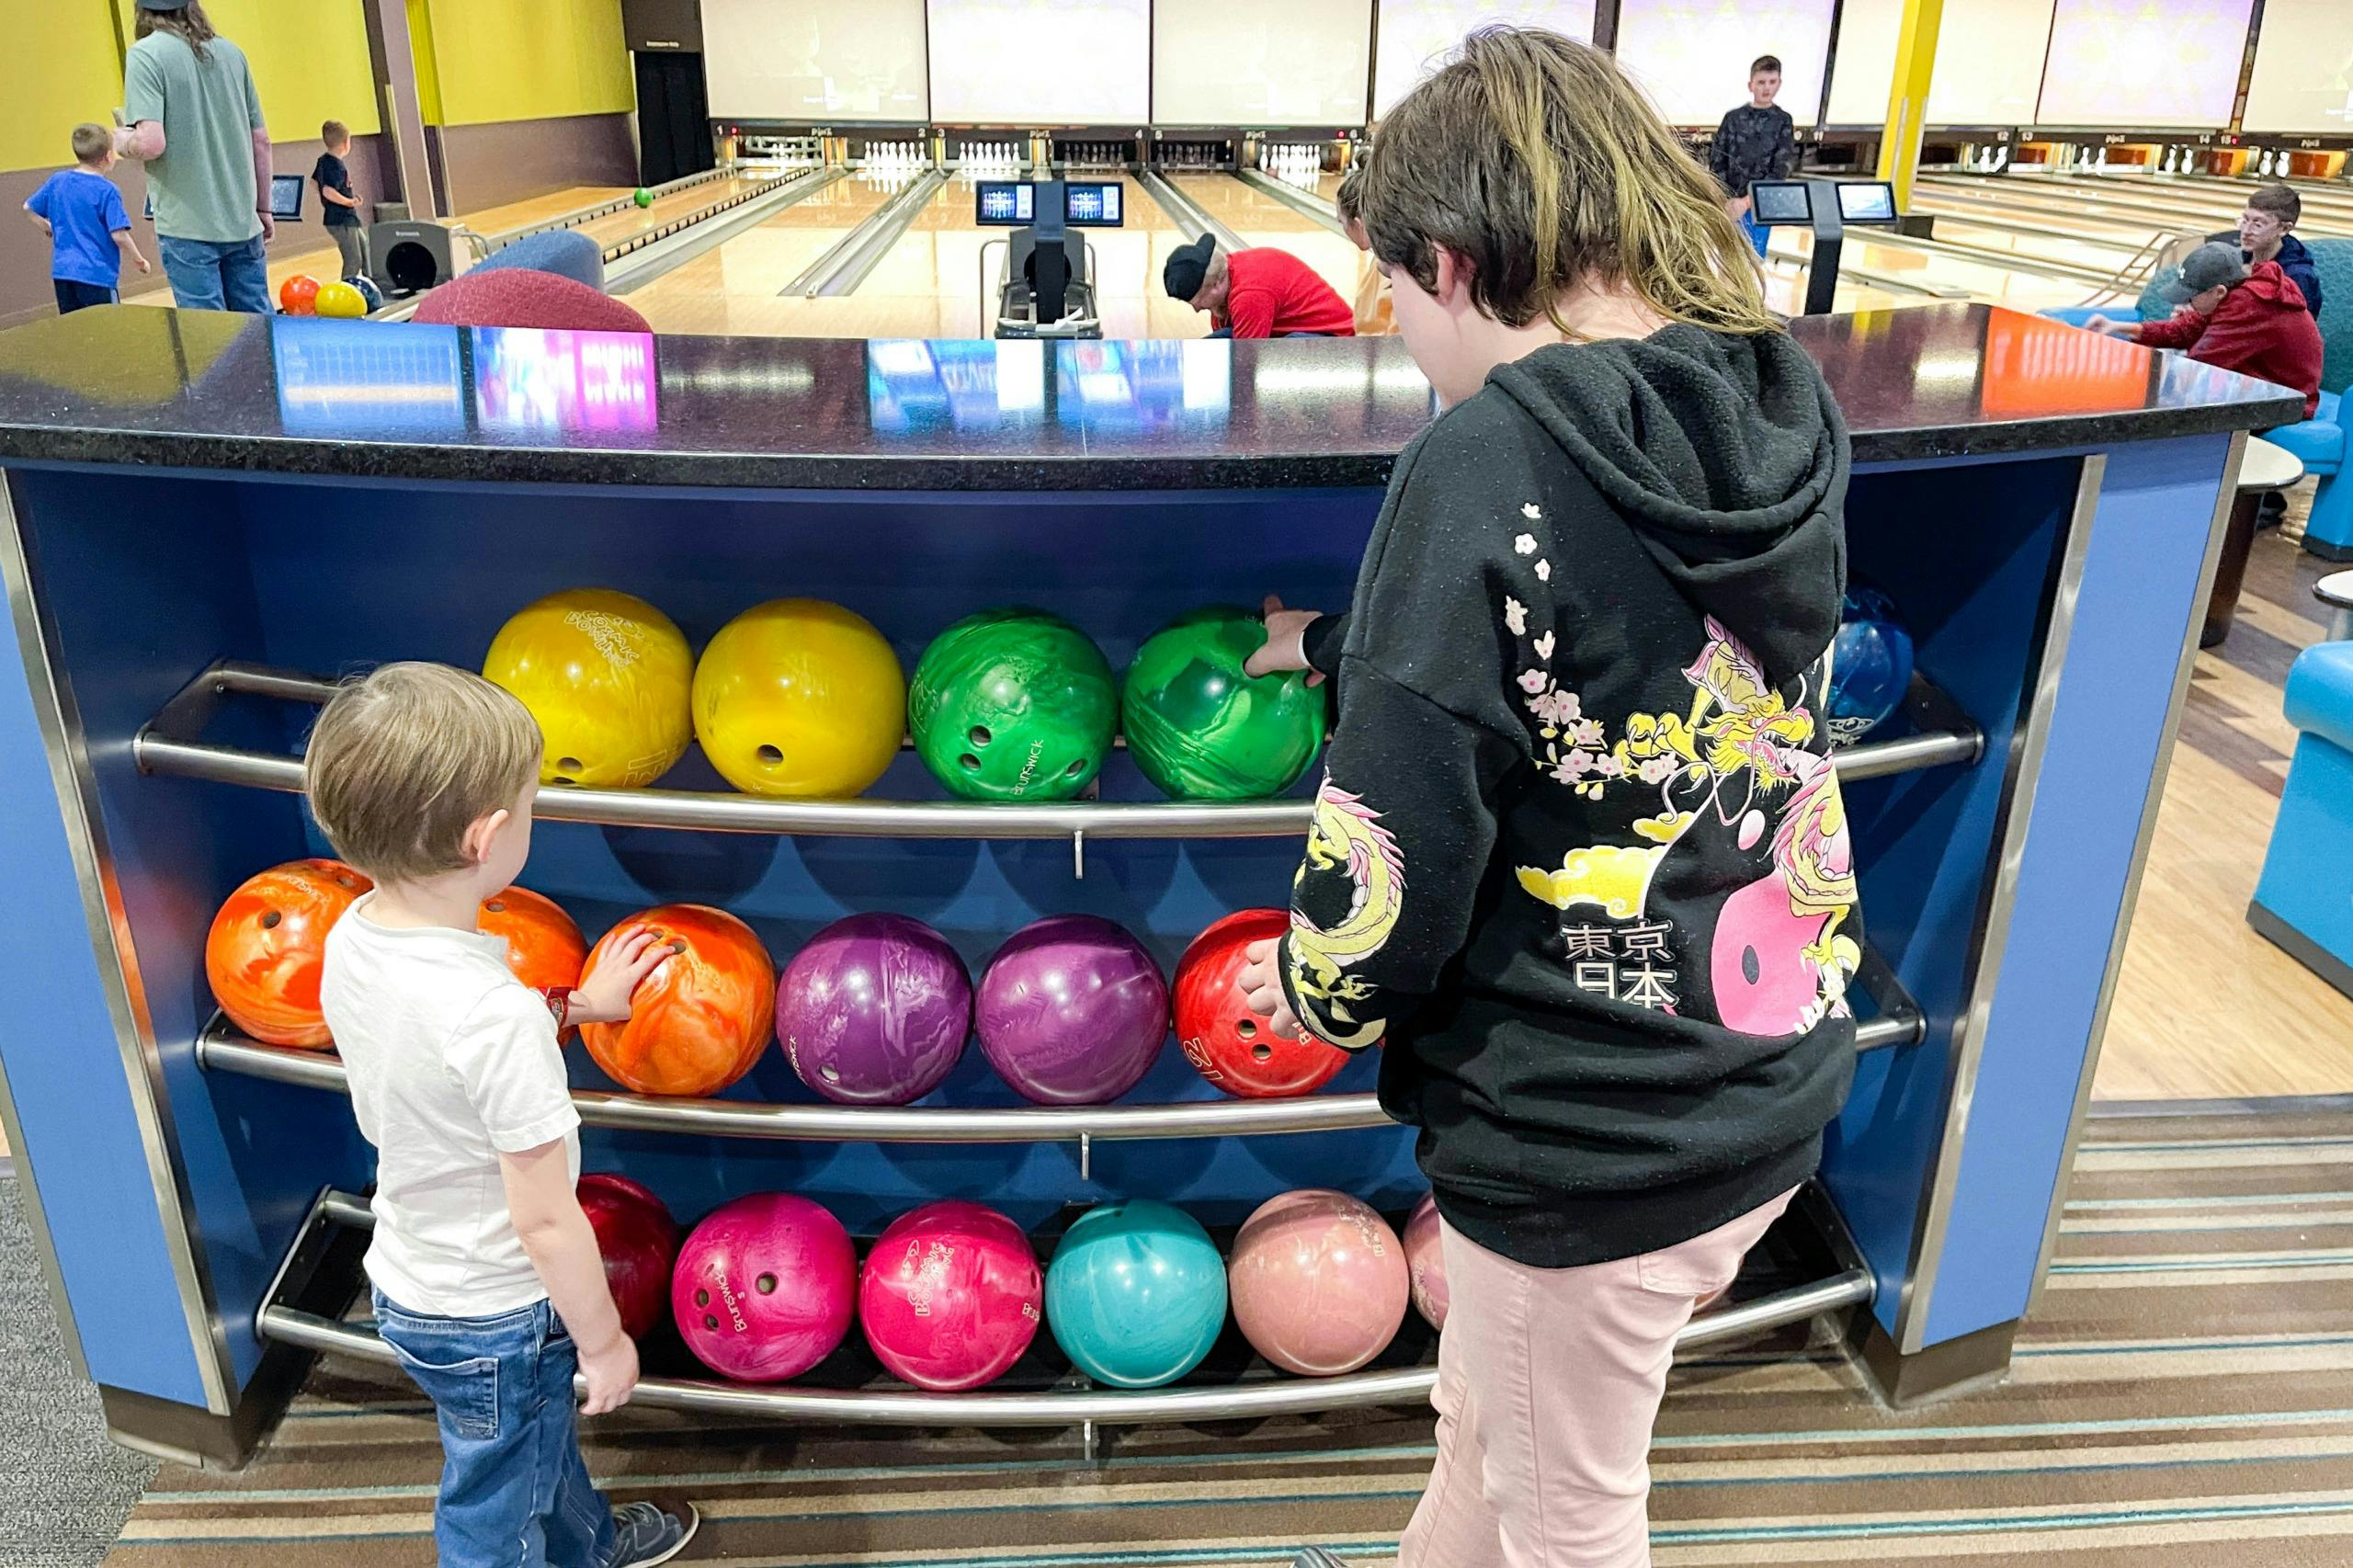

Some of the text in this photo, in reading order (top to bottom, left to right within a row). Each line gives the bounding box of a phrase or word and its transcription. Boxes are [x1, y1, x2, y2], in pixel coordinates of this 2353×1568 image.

[582, 610, 640, 660] COSMIC
[1561, 920, 1673, 960] 東京
[1574, 961, 1677, 1009] 日本
[715, 1269, 747, 1332] Brunswick
